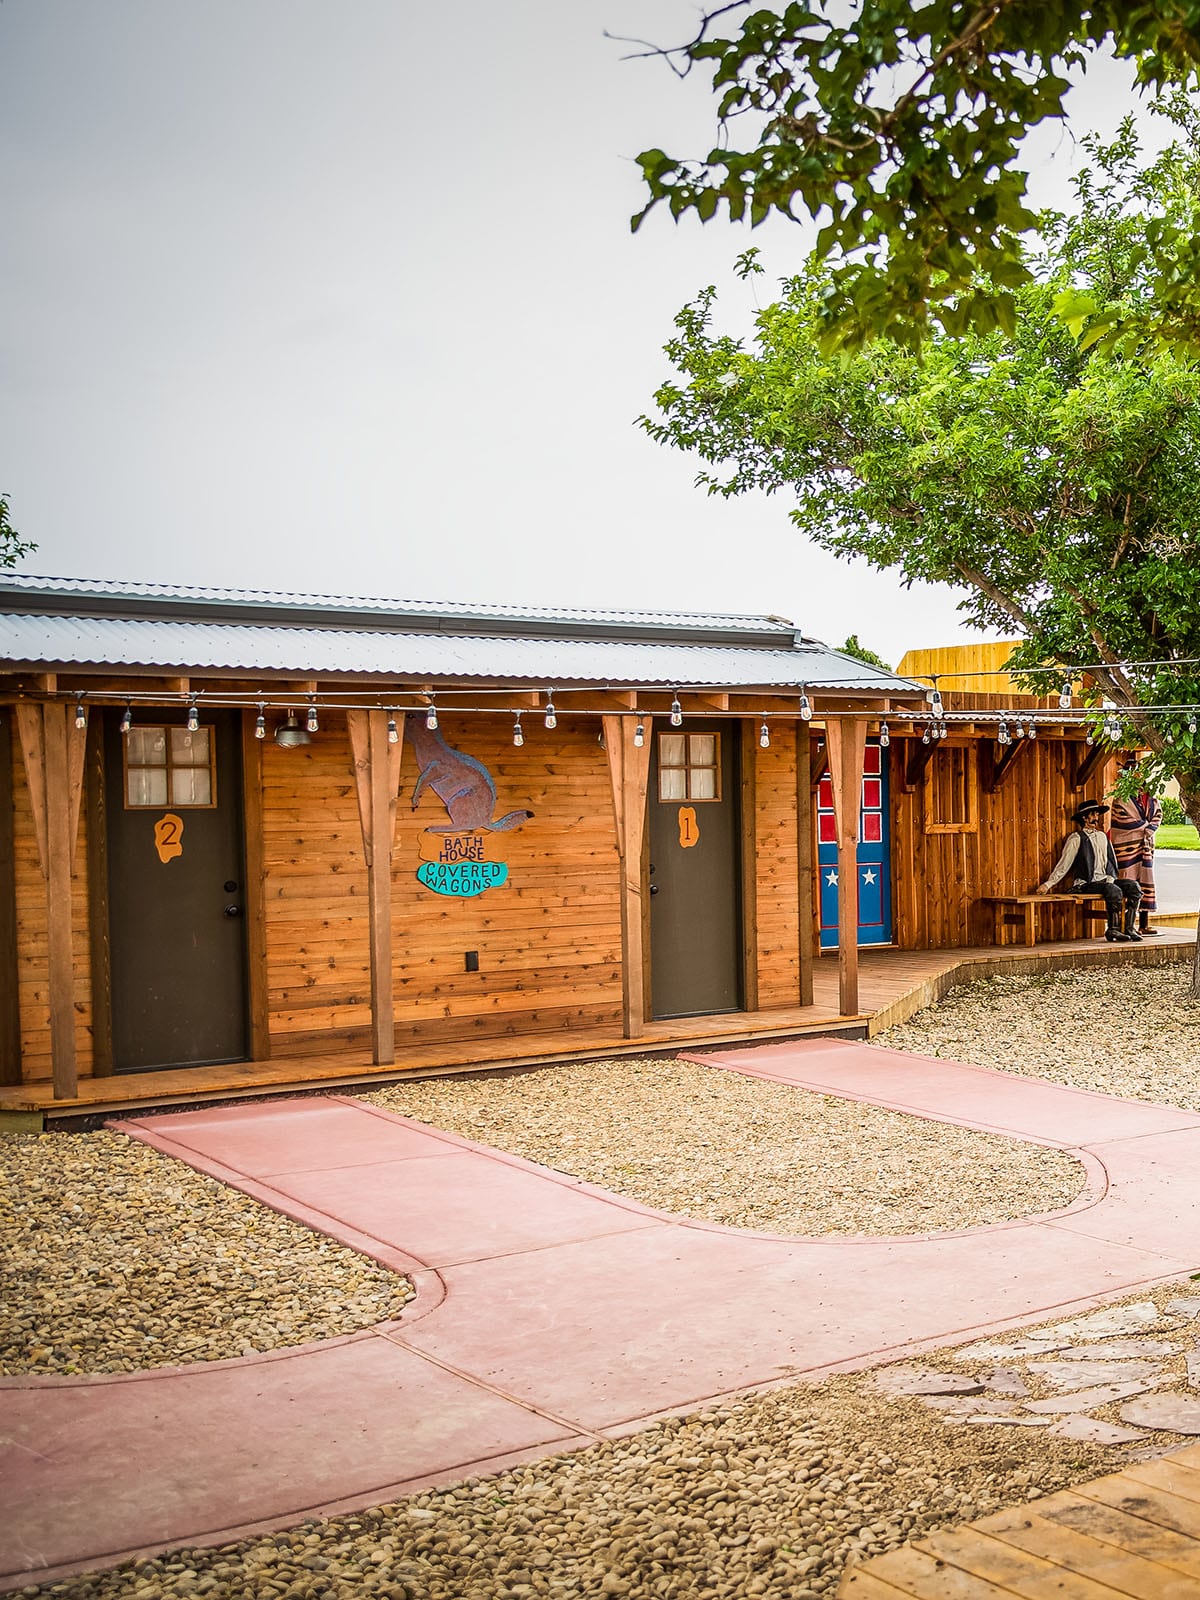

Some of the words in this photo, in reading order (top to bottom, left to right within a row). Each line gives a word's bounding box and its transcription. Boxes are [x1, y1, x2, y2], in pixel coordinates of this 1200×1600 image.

[161, 821, 177, 845] 2
[684, 817, 691, 840] 1
[444, 836, 483, 851] BATH
[439, 846, 485, 862] HOUSE
[426, 862, 501, 878] COVERED
[425, 874, 493, 893] WAGONS
